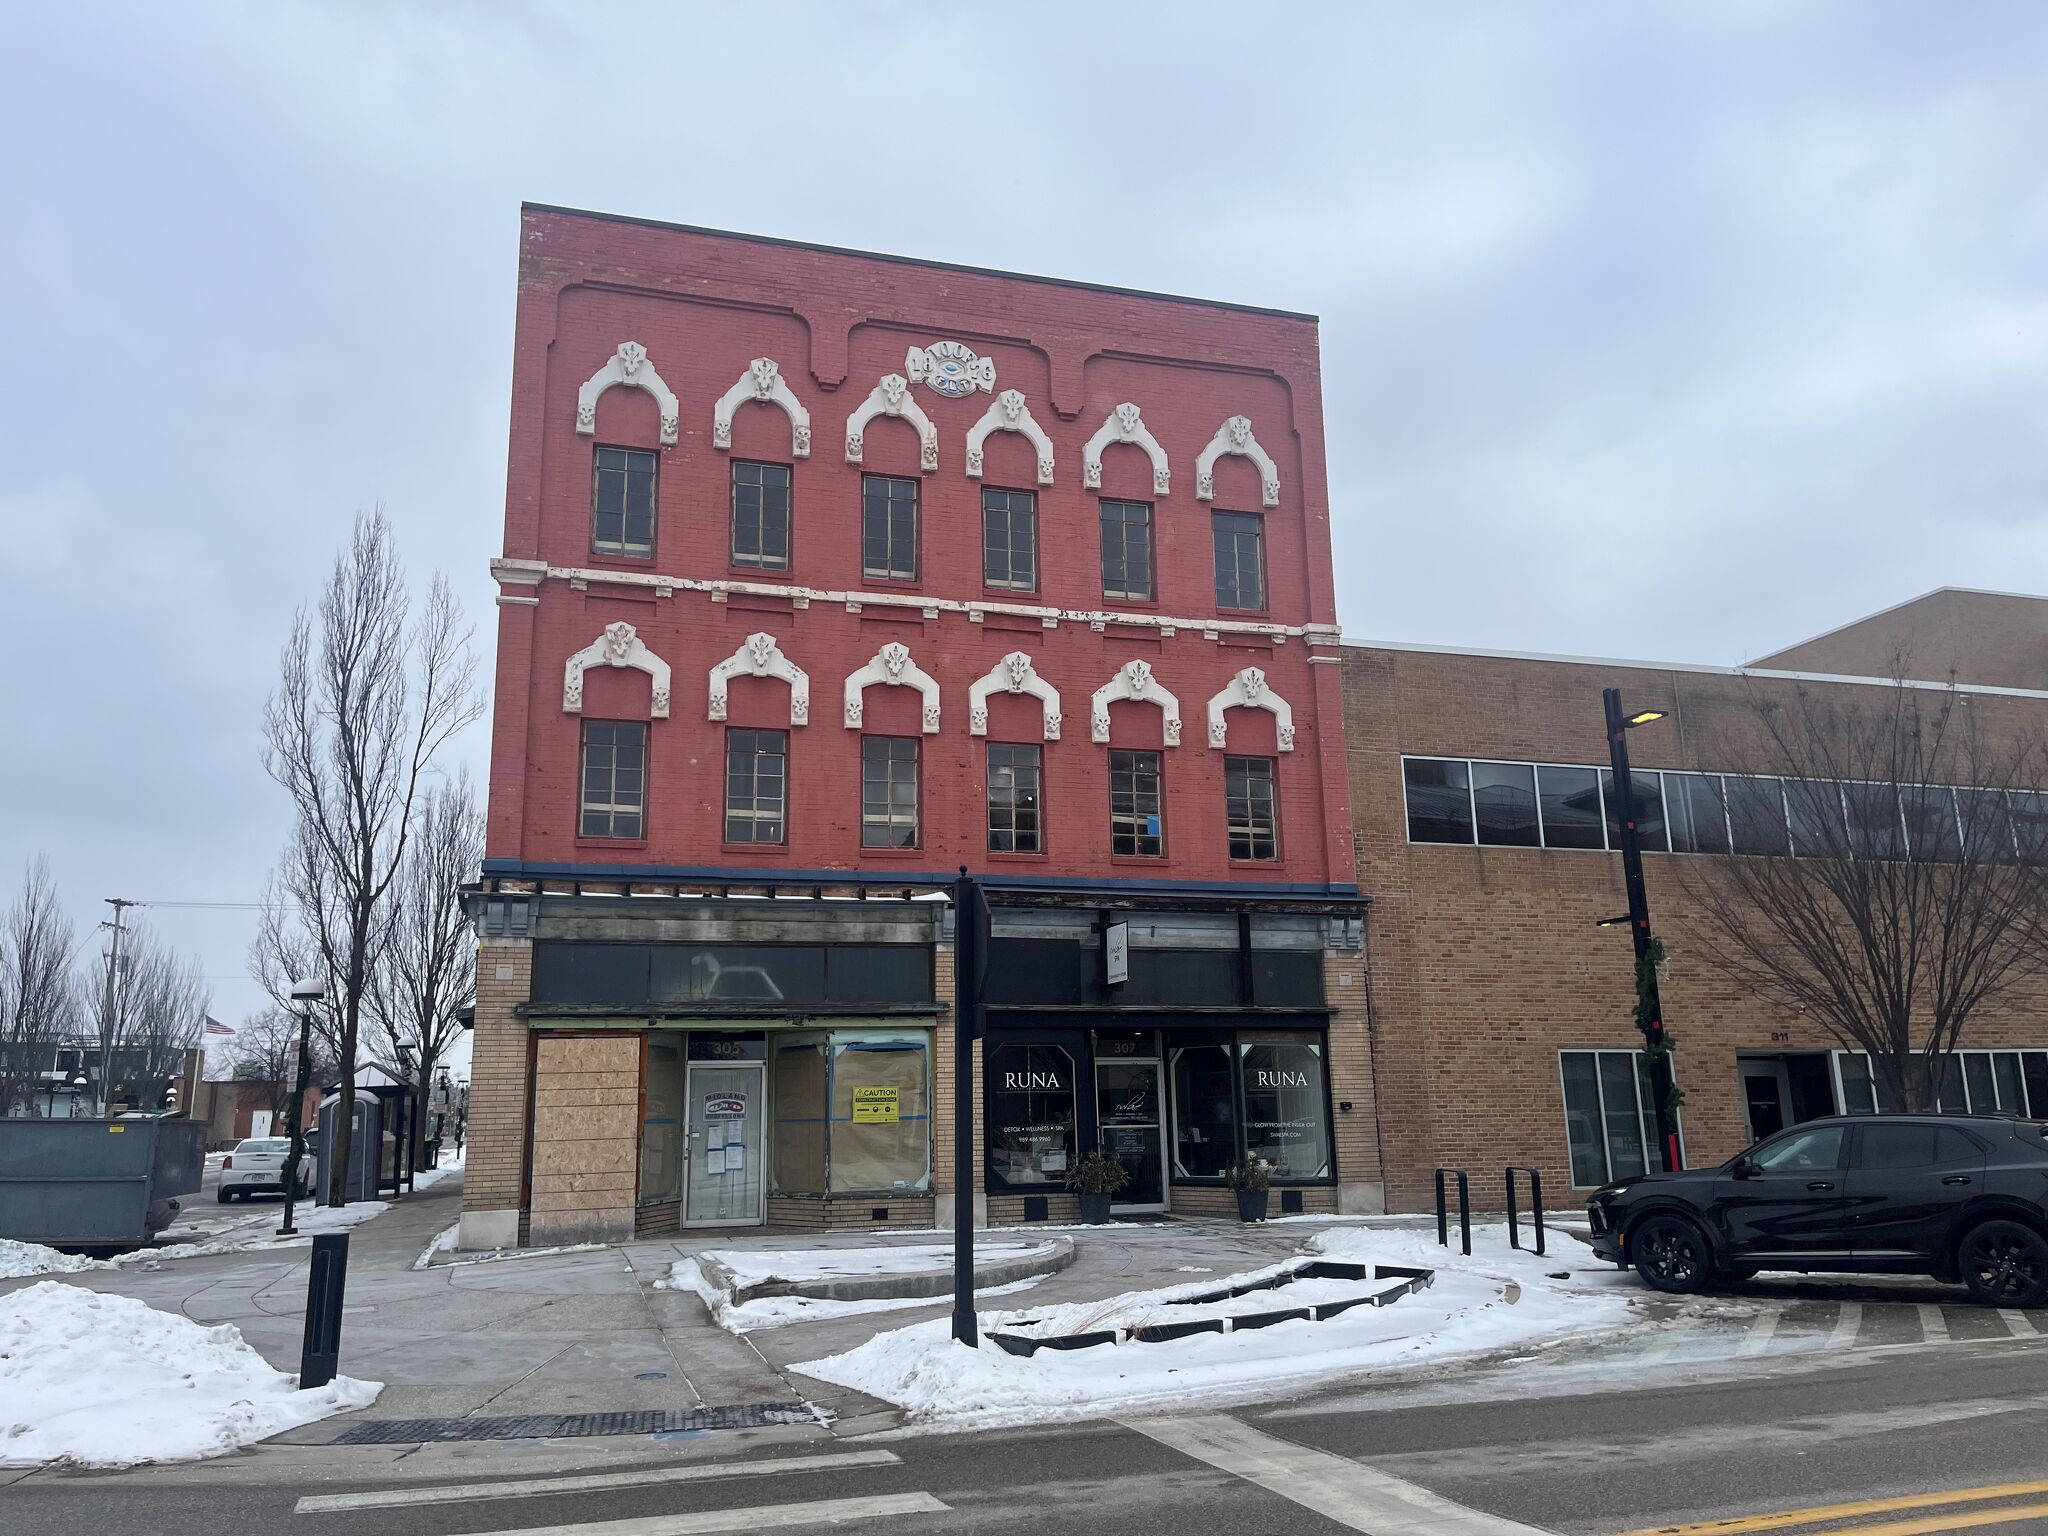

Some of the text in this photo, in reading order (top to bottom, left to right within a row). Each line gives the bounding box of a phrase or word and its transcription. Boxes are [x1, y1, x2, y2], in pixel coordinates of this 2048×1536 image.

[1771, 1032, 1789, 1041] 311
[713, 1041, 740, 1053] 305
[1114, 1043, 1136, 1053] 307
[1005, 1072, 1060, 1088] RUNA
[1258, 1071, 1308, 1086] RUNA
[705, 1093, 746, 1102] MIDLAND
